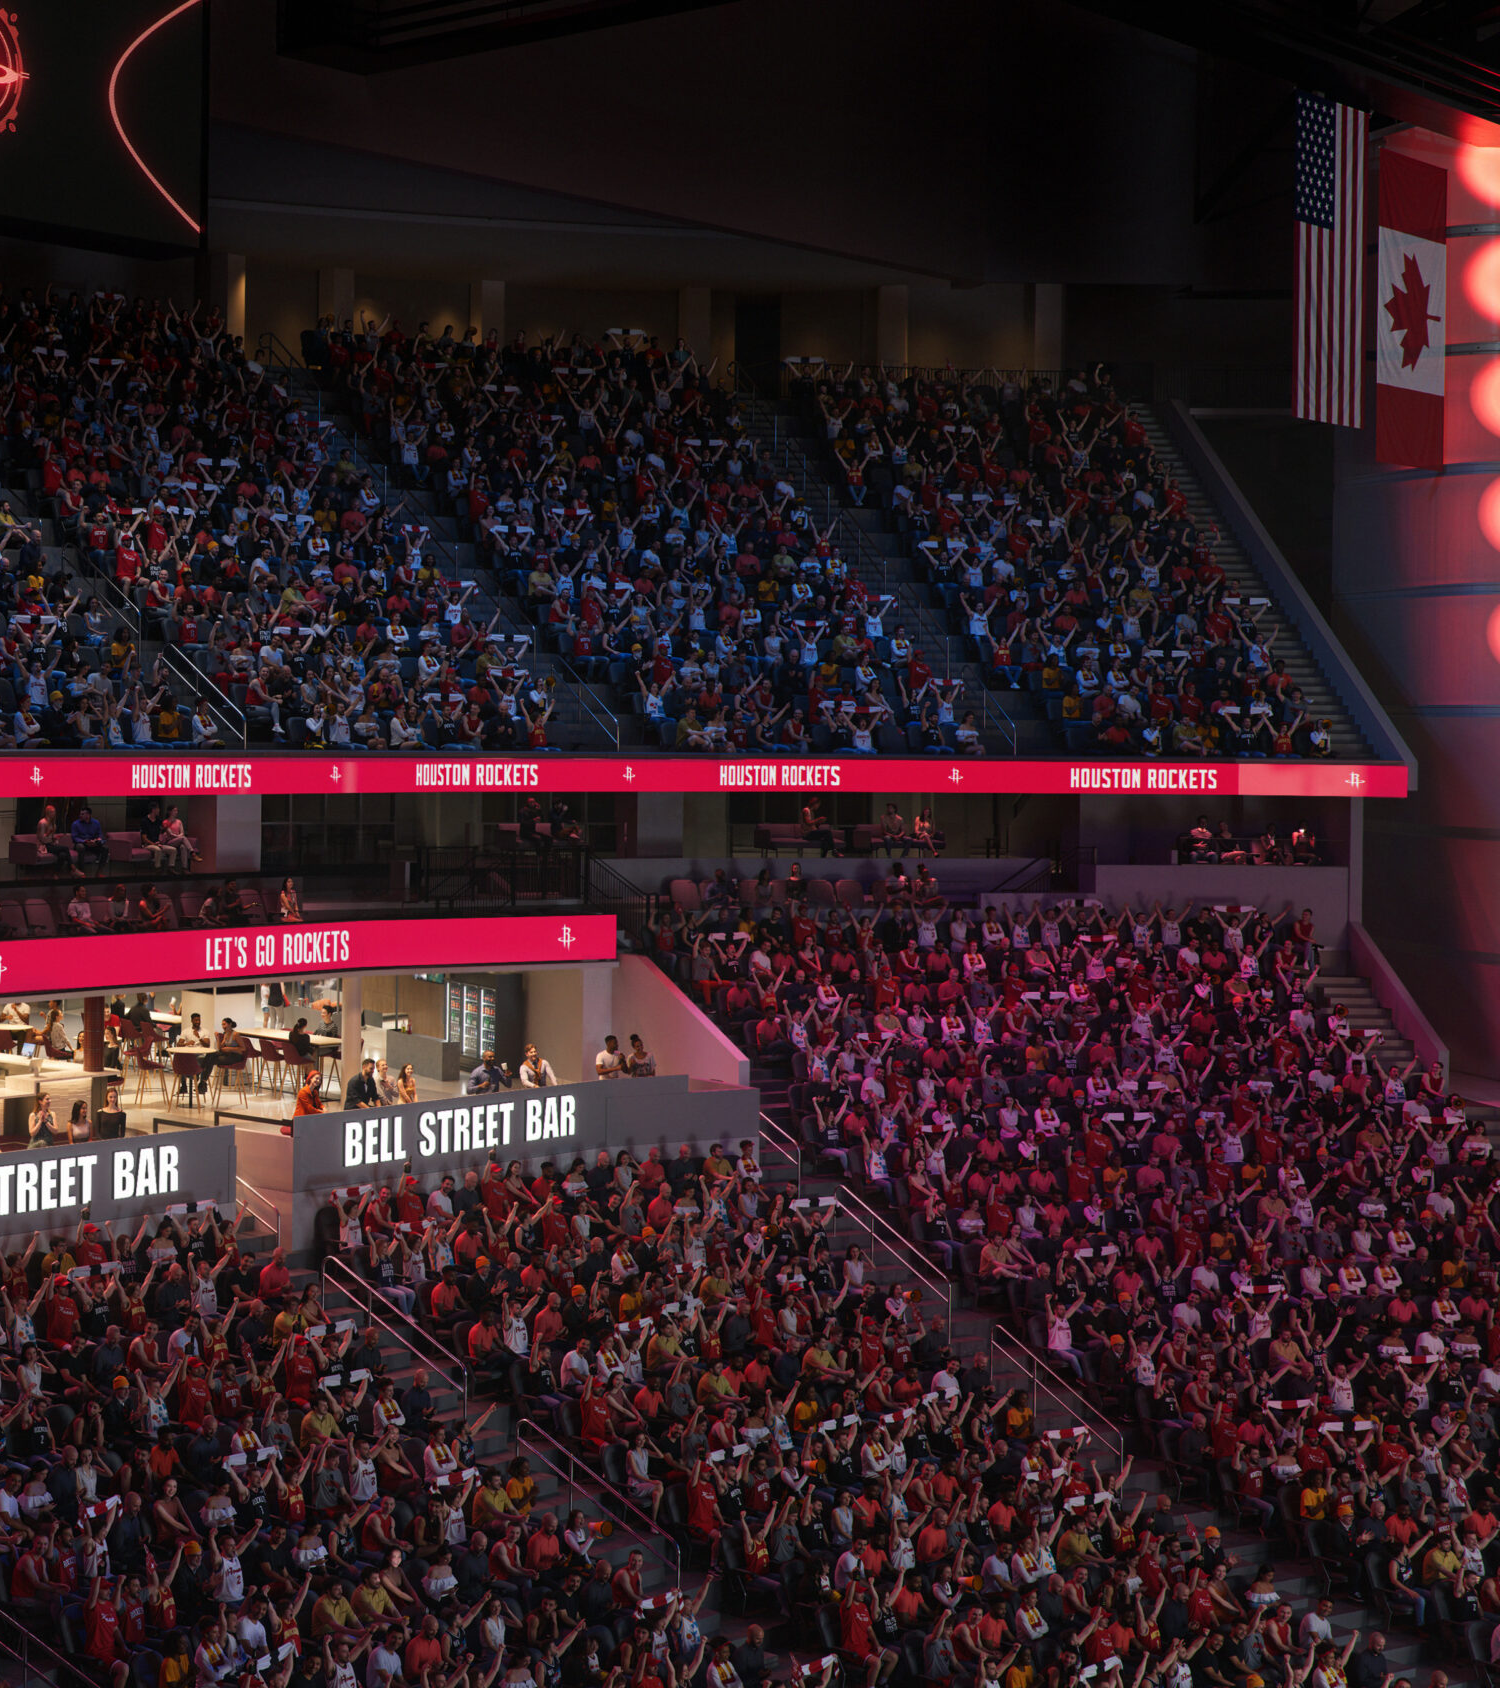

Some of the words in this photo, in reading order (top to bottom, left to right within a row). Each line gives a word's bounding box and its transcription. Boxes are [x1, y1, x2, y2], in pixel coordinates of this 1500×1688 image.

[132, 765, 190, 788] HOUSTON
[196, 764, 251, 788] ROCKETS
[416, 764, 471, 786] HOUSTON
[476, 764, 538, 786] ROCKETS
[720, 765, 776, 786] HOUSTON
[782, 765, 840, 786] ROCKETS
[1071, 768, 1141, 789] HOUSTON
[1148, 769, 1218, 789] ROCKETS
[206, 936, 248, 971] LET'S
[256, 934, 276, 967] GO
[283, 930, 350, 965] ROCKETS
[344, 1116, 407, 1168] BELL
[419, 1102, 515, 1157] STREET
[525, 1095, 576, 1142] BAR
[113, 1145, 179, 1200] BAR
